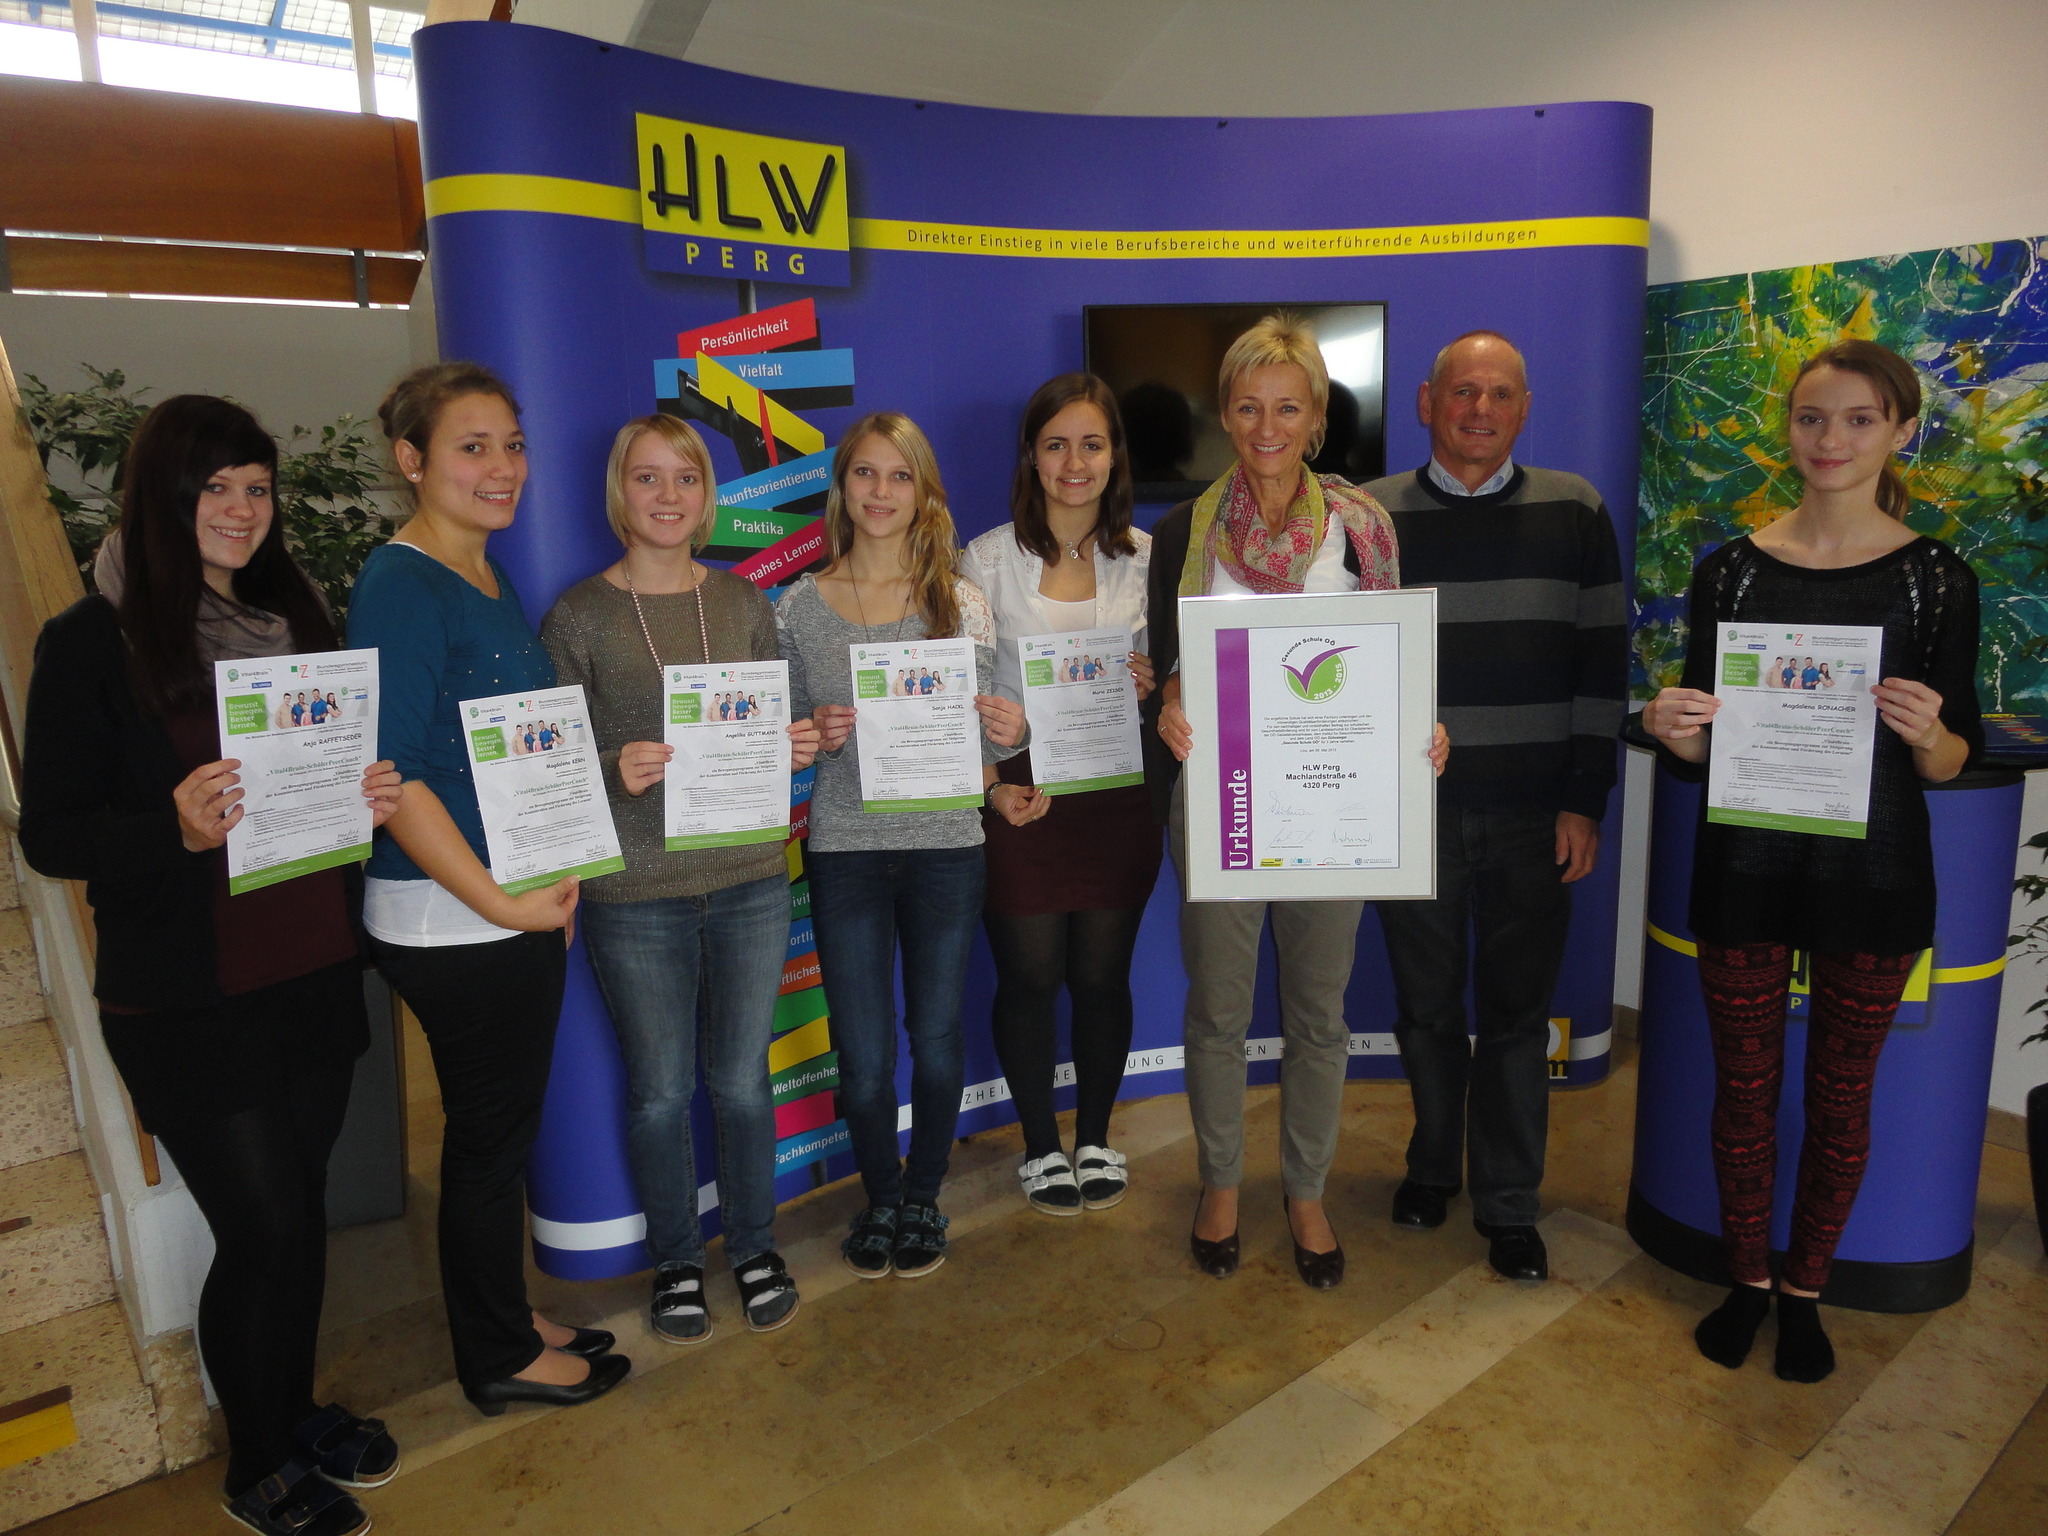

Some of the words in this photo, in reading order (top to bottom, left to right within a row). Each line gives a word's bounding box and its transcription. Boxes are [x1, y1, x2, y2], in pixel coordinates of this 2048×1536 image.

[648, 133, 836, 235] HLW
[908, 229, 973, 246] Direkter
[980, 234, 1042, 252] Einstieg
[1050, 237, 1063, 250] in
[1070, 237, 1108, 251] viele
[1116, 236, 1240, 251] Berufsbereiche
[1248, 238, 1276, 250] und
[1283, 234, 1413, 250] weiterführende
[1420, 228, 1537, 246] Ausbildungen
[686, 242, 806, 275] PERG
[701, 318, 789, 351] Persönlichkeit
[738, 364, 784, 378] Vielfalt
[716, 466, 827, 507] ukunftsorientierung
[733, 519, 784, 536] Praktika
[746, 557, 783, 583] nahes
[784, 535, 823, 563] Lernen
[1302, 636, 1323, 644] Schule
[300, 664, 308, 678] Z
[1313, 688, 1334, 700] 2013
[1334, 663, 1343, 684] 2015
[230, 714, 254, 723] Besser
[319, 732, 361, 745] RAFFETSEDER
[1286, 772, 1346, 780] Machlandstraße
[1322, 764, 1340, 772] Perg
[1322, 782, 1340, 790] Perg
[1228, 770, 1249, 868] Urkunde
